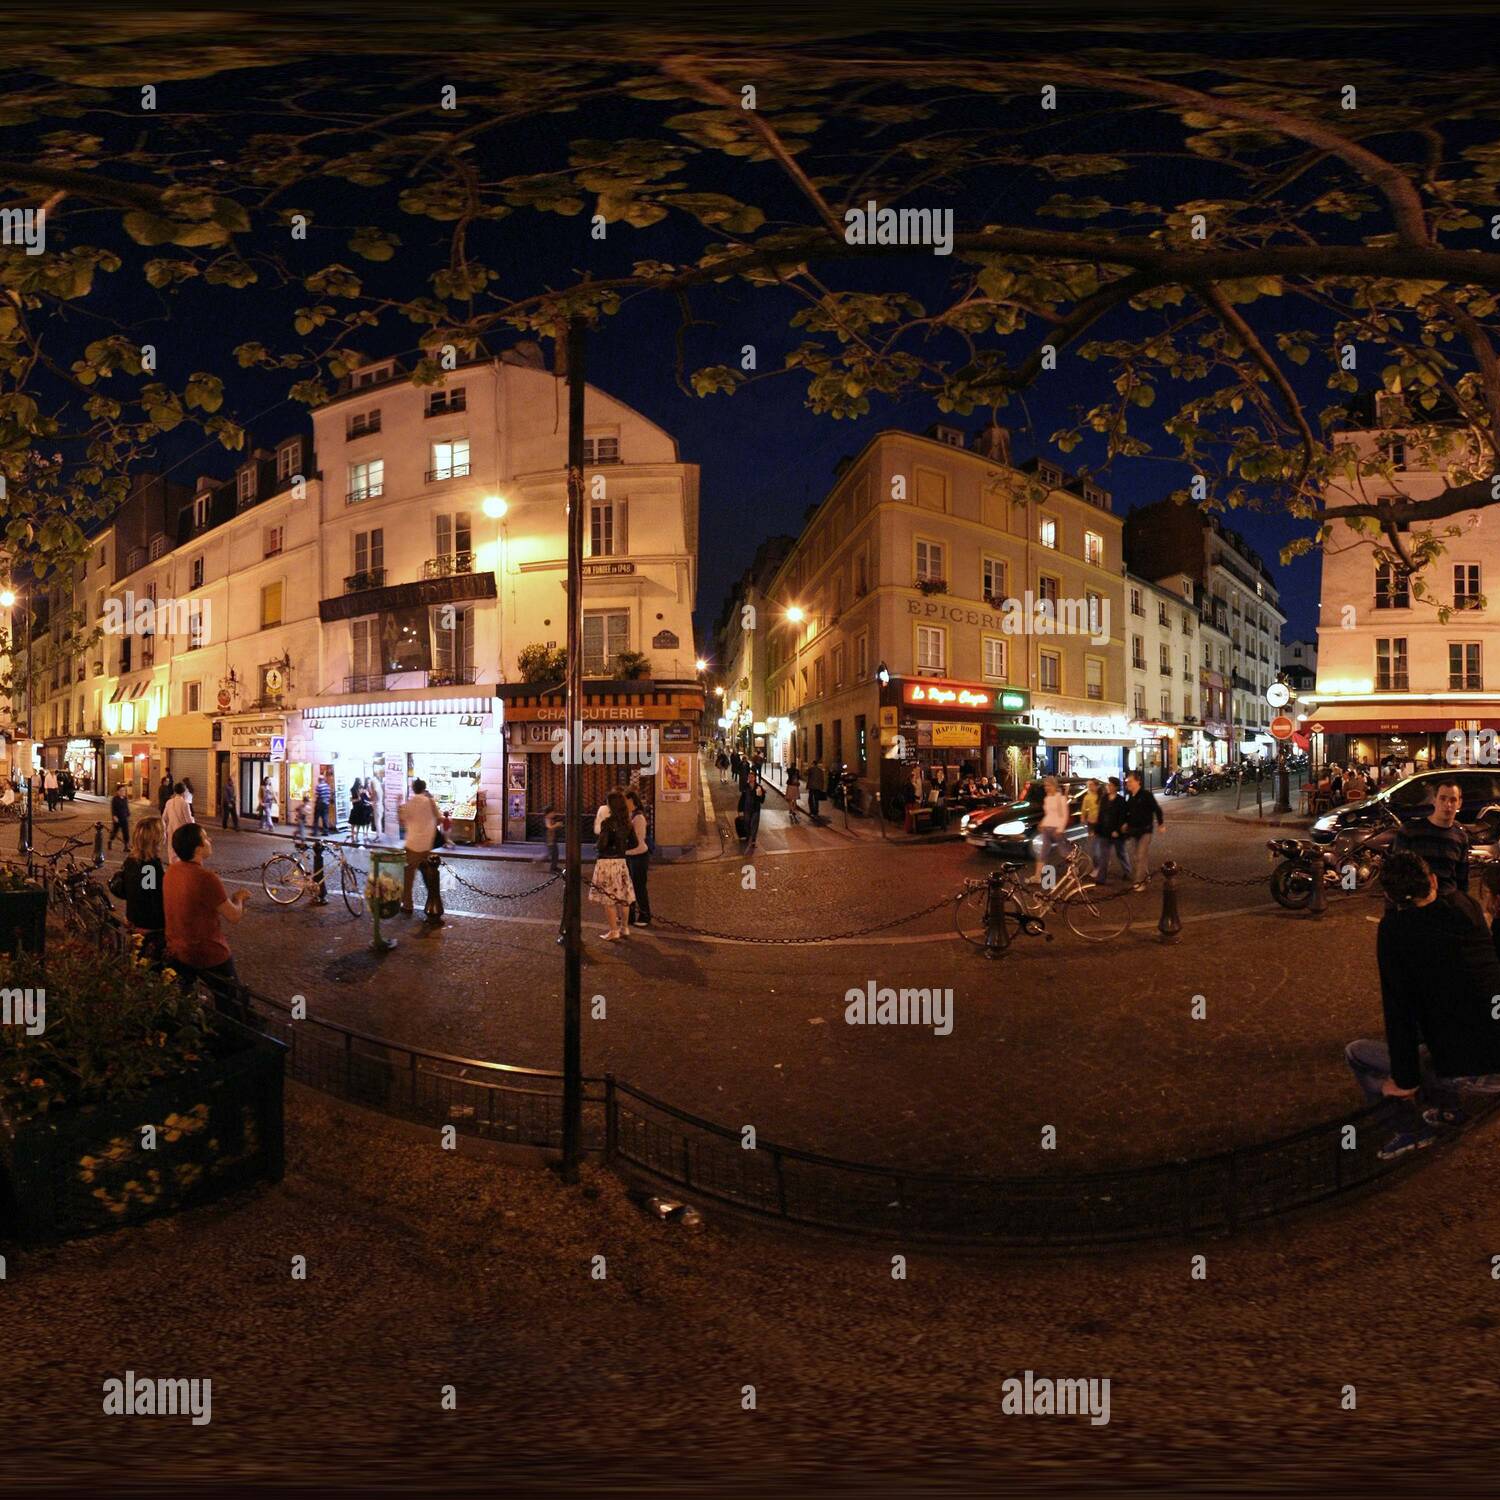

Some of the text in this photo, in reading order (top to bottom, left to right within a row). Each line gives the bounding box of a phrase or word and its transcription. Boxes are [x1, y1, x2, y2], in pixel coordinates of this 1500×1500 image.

[907, 599, 1003, 629] EPICERI
[537, 707, 644, 721] CHACUTERIE
[341, 717, 438, 729] SUPERMARCHE
[935, 725, 979, 736] HAPPY HOUR
